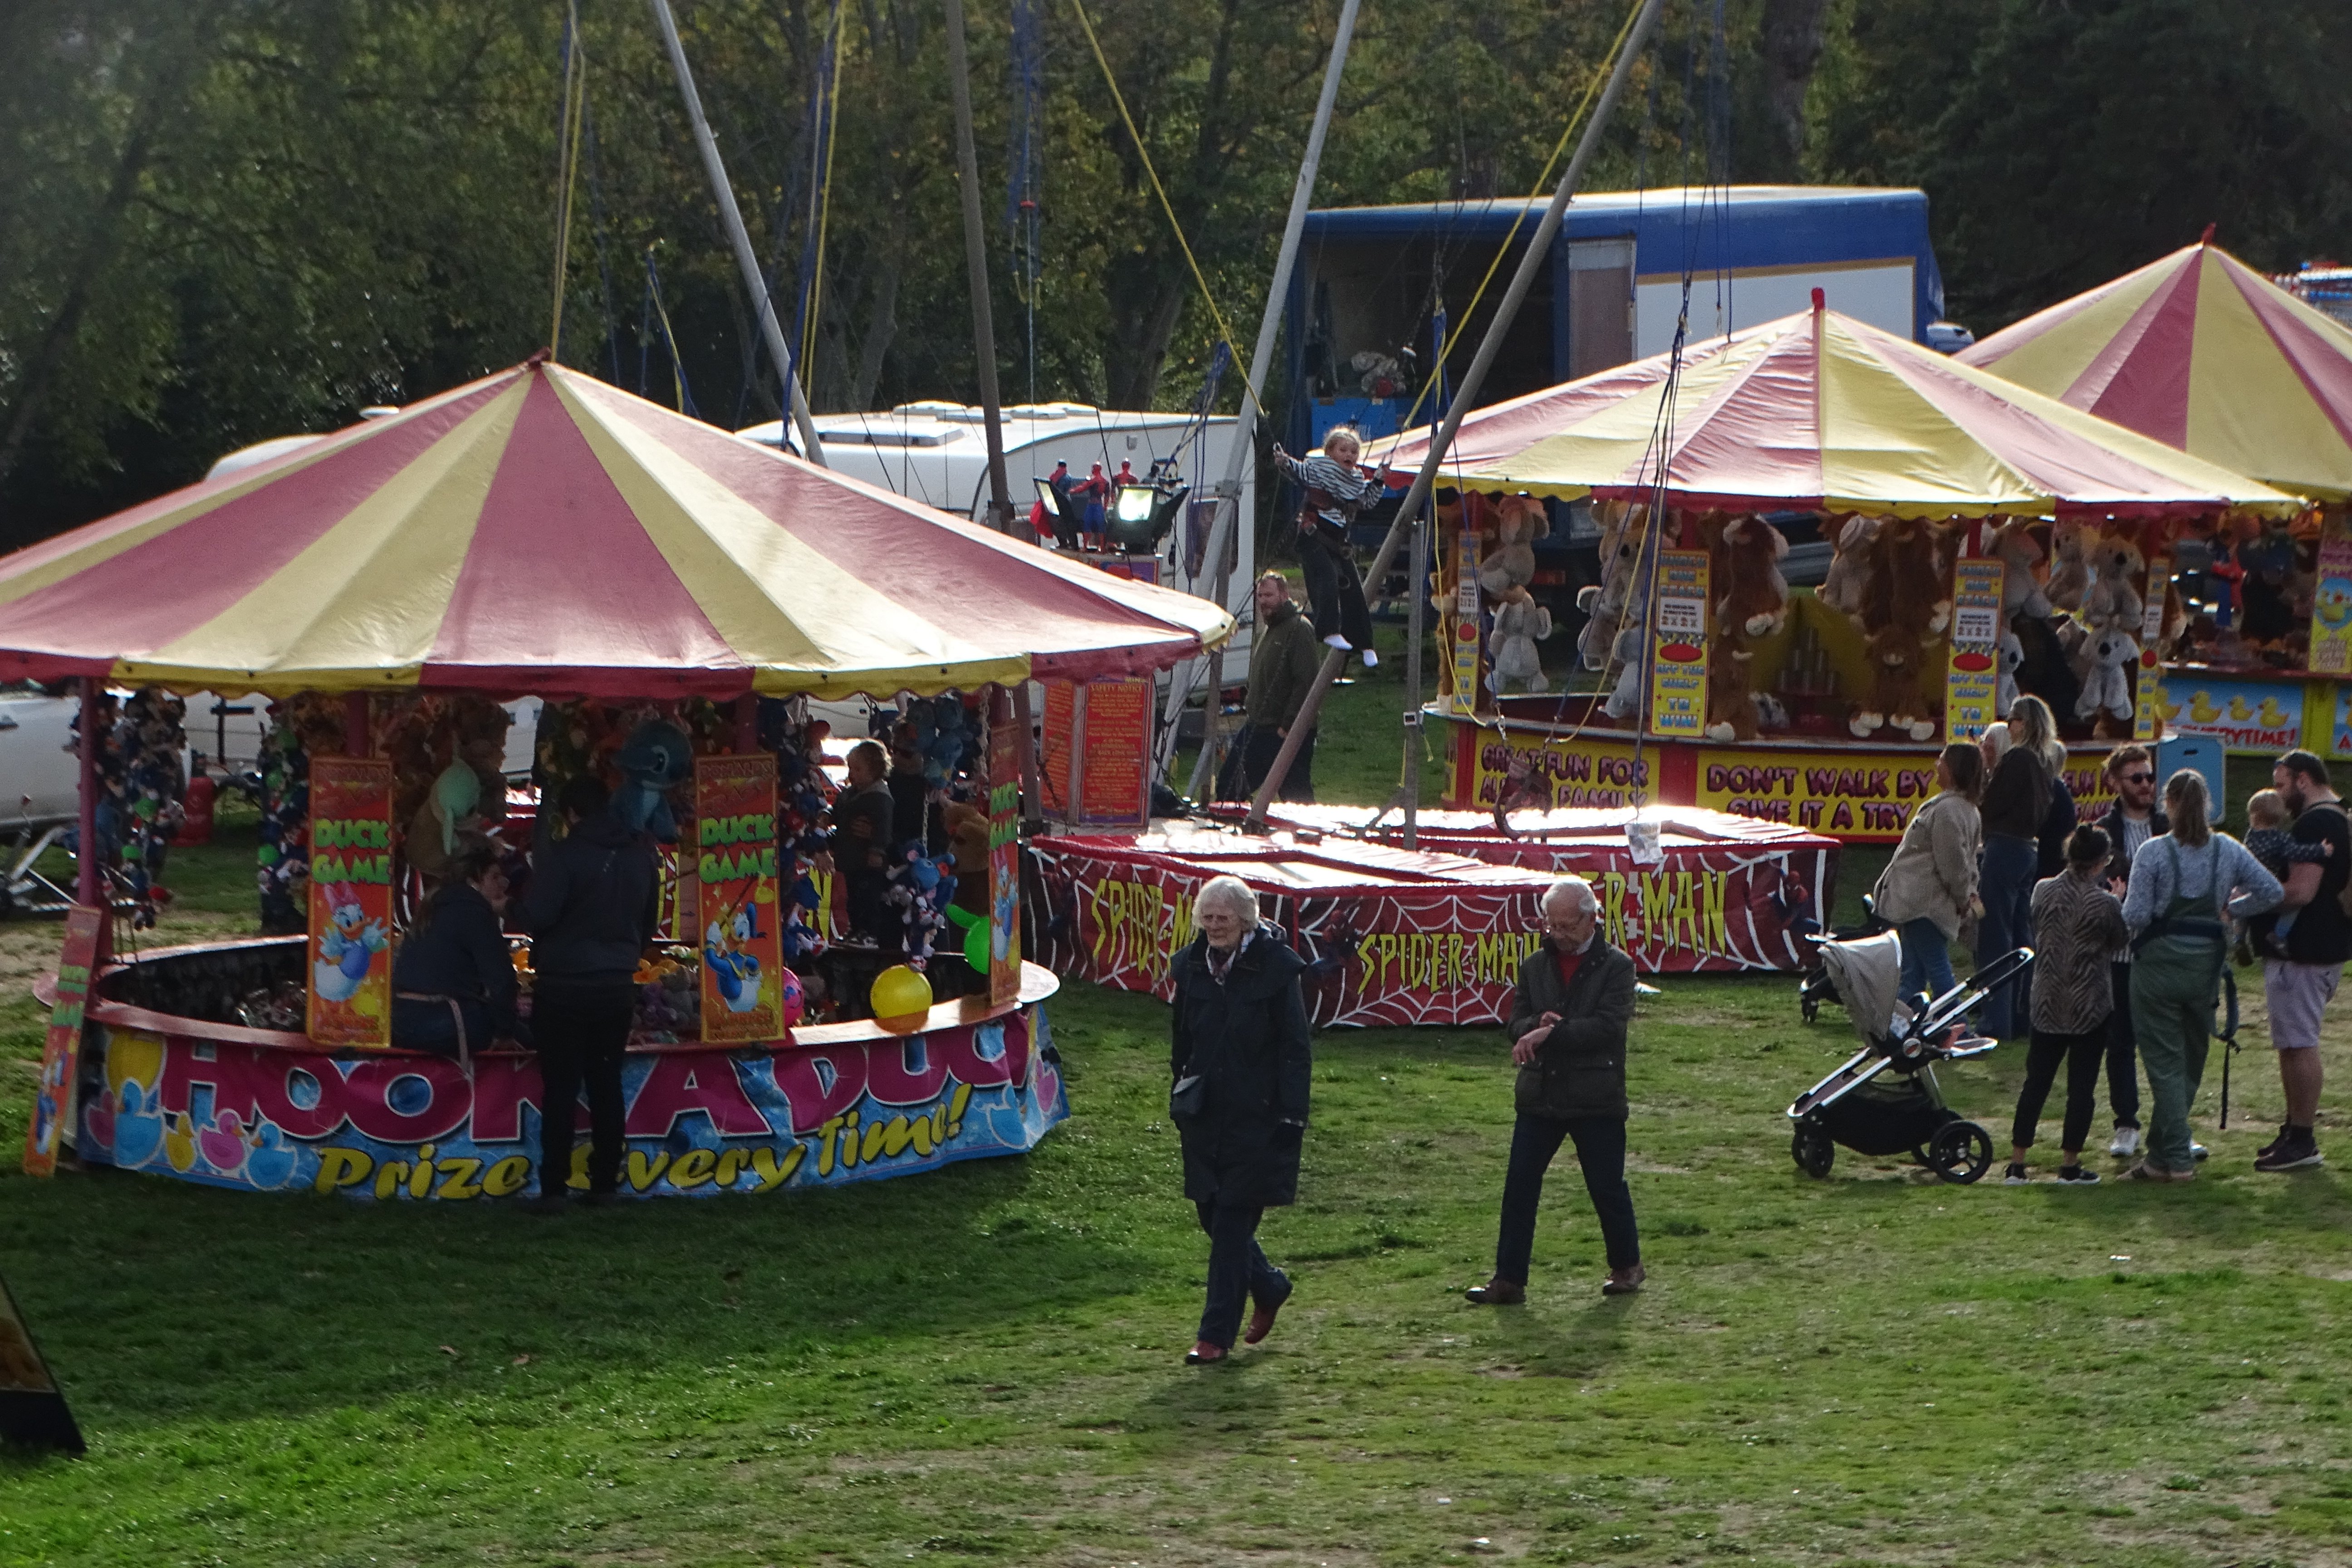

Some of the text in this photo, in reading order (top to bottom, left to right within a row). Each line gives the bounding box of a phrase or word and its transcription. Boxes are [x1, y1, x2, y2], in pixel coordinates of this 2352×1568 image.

[1667, 697, 1690, 712] TO
[1544, 751, 1592, 782] FUN
[1597, 756, 1649, 788] FOR
[1706, 764, 1935, 799] DON'T WALK BY
[701, 814, 775, 847] DUCK
[1727, 797, 1914, 831] GIVE IT A TRY
[314, 818, 391, 848] DUCK
[311, 854, 391, 884] GAME
[699, 847, 776, 884] GAME
[624, 1053, 774, 1137] A
[314, 1143, 533, 1201] Prize
[817, 1081, 973, 1178] Time!
